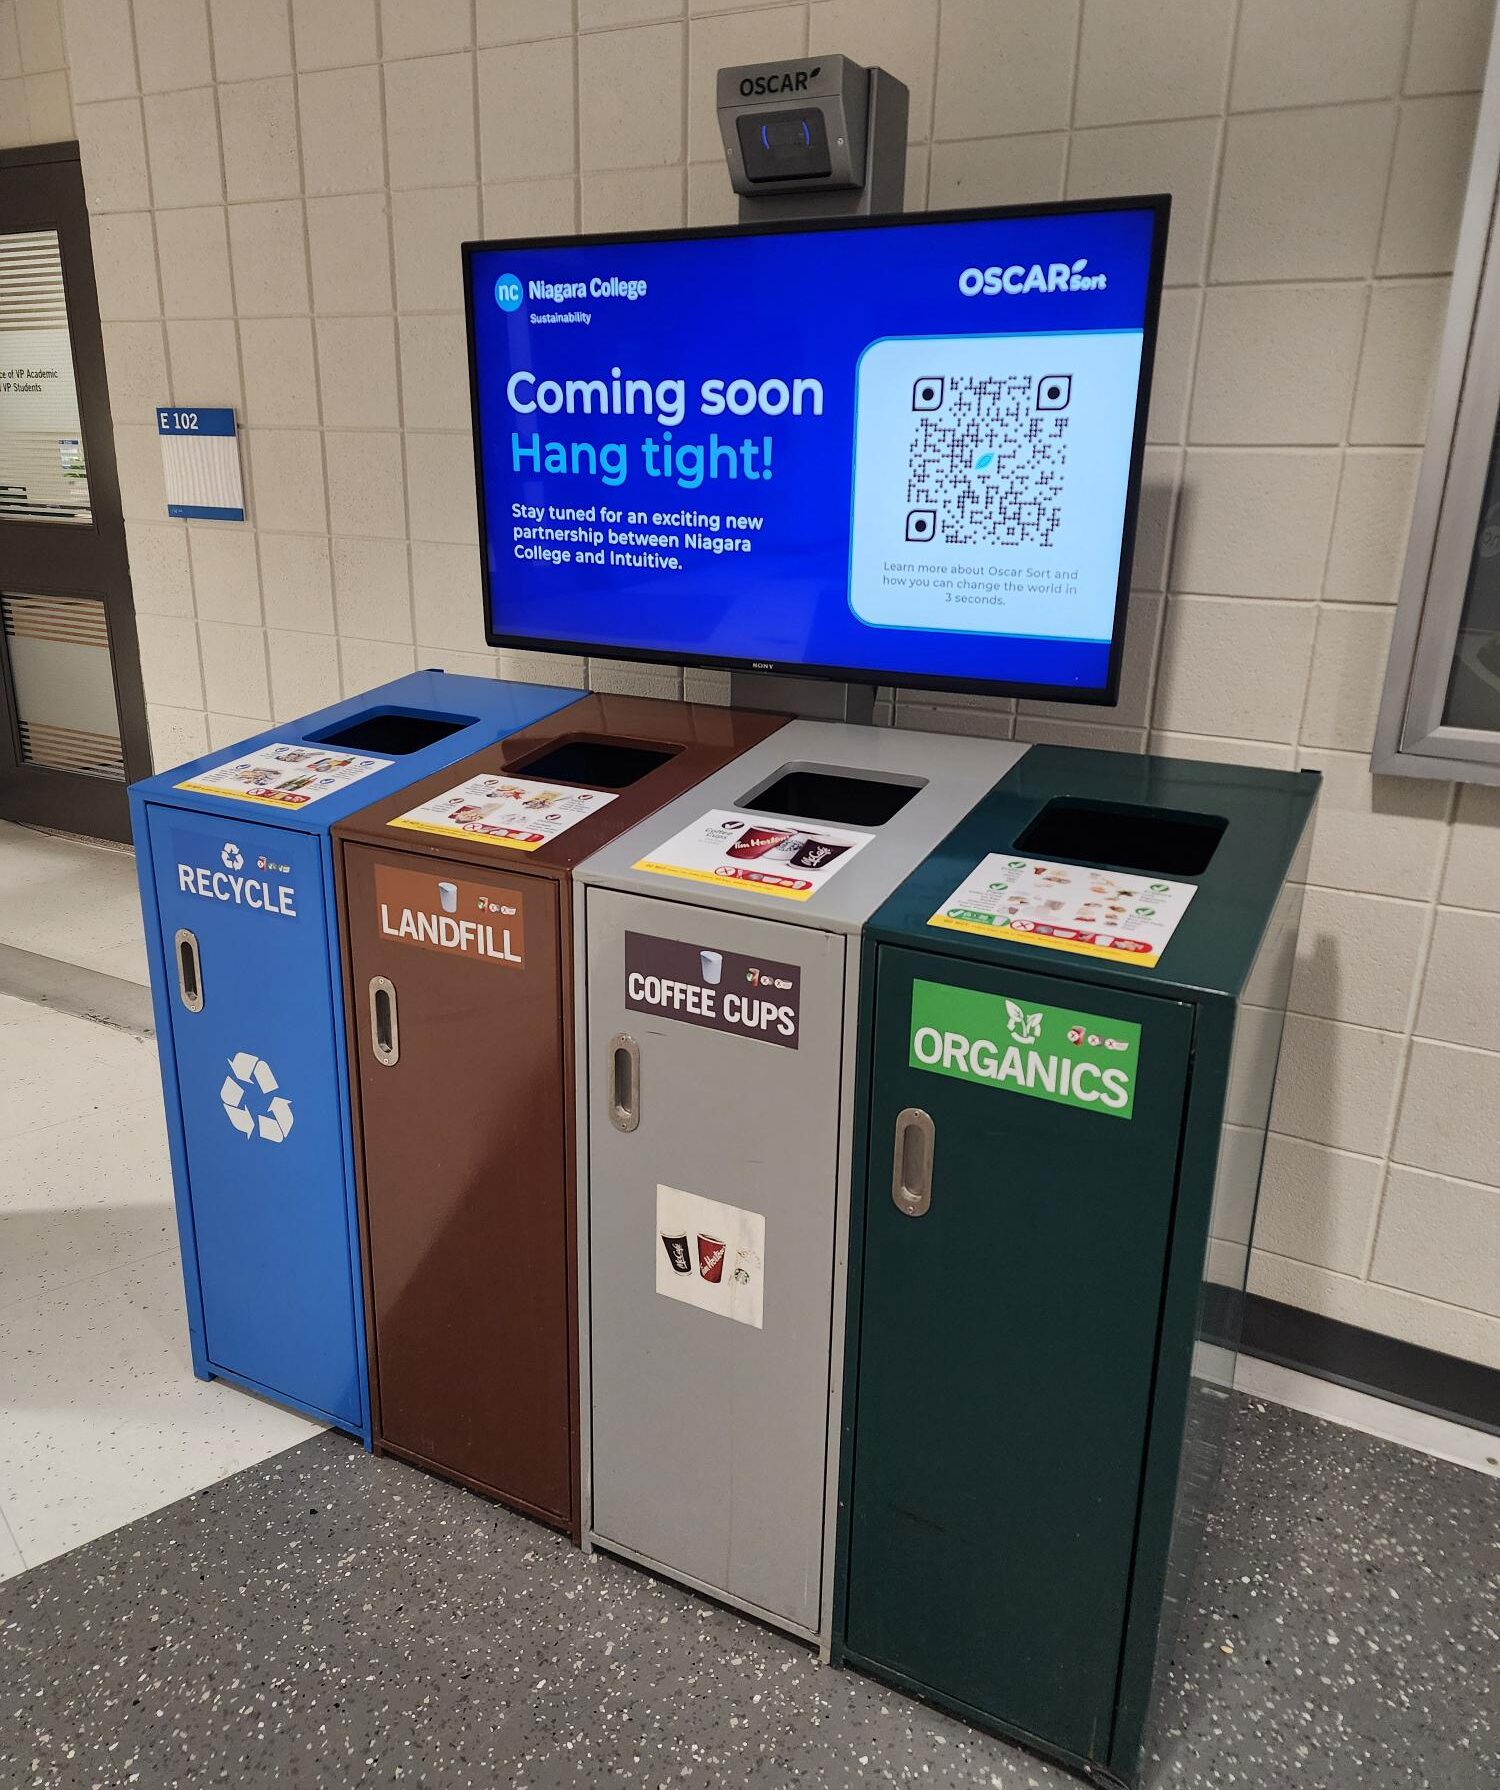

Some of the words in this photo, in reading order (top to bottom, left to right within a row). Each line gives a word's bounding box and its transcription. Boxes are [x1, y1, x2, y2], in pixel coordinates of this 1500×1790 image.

[740, 72, 808, 97] OSCAR
[528, 280, 587, 303] Niagara
[589, 277, 647, 301] College
[958, 262, 1070, 297] OSCAR
[498, 284, 519, 301] nc
[530, 312, 592, 325] Sustainability
[8, 369, 14, 379] of
[15, 369, 25, 379] VP
[26, 368, 59, 379] Academic
[3, 382, 12, 392] VP
[13, 382, 42, 392] Students
[507, 367, 685, 426] Coming
[700, 378, 824, 416] soon
[160, 413, 170, 429] E
[173, 413, 199, 430] 102
[511, 432, 627, 486] Hang
[641, 431, 773, 489] tight!
[511, 503, 545, 522] Stay
[549, 505, 596, 522] tuned
[600, 507, 622, 524] for
[627, 511, 648, 525] an
[652, 511, 720, 531] exciting
[726, 515, 764, 530] new
[513, 526, 604, 546] partnership
[608, 529, 679, 548] between
[685, 533, 751, 554] Niagara
[514, 545, 571, 565] College
[575, 549, 605, 565] and
[610, 551, 683, 570] Intuitive.
[884, 561, 915, 572] Learn
[918, 564, 948, 574] more
[951, 564, 984, 575] about
[988, 566, 1023, 577] Oscar
[1026, 567, 1051, 579] Sort
[1054, 569, 1079, 580] and
[883, 576, 907, 586] how
[908, 578, 930, 589] you
[933, 579, 954, 588] can
[956, 579, 1000, 593] change
[1004, 581, 1024, 592] the
[1027, 583, 1062, 594] world
[1066, 584, 1077, 595] in
[945, 592, 952, 602] 3
[955, 594, 1006, 606] seconds.
[752, 662, 774, 670] SONY
[735, 840, 750, 849] Tim
[178, 864, 297, 917] RECYCLE
[381, 904, 522, 963] LANDFILL
[628, 972, 716, 1018] COFFEE
[723, 994, 795, 1036] CUPS
[914, 1027, 1130, 1109] ORGANICS
